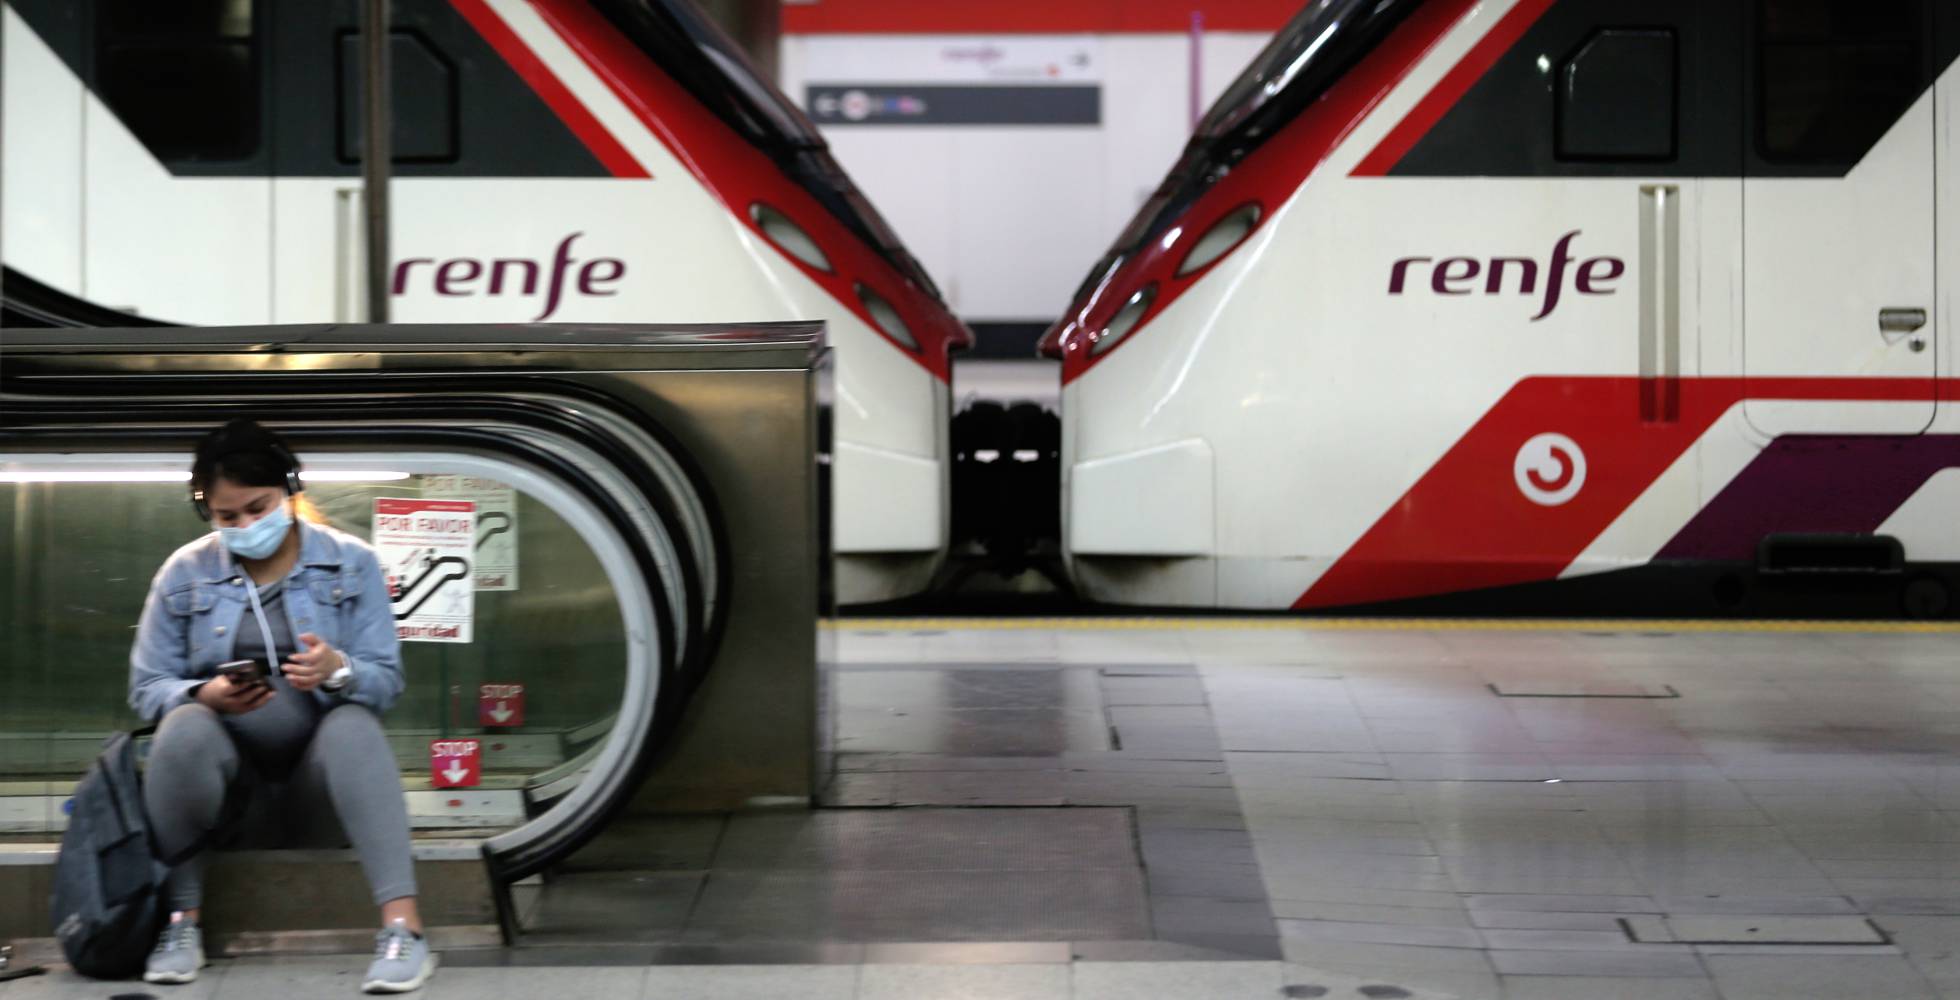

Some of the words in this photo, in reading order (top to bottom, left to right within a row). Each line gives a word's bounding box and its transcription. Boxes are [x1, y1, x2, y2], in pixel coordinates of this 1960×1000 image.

[391, 230, 626, 322] renfe
[1388, 229, 1625, 322] renfe
[378, 517, 412, 531] POR
[418, 518, 471, 533] FAVOR
[396, 624, 460, 639] guridad
[479, 684, 523, 699] STOP
[431, 741, 478, 757] STOP
